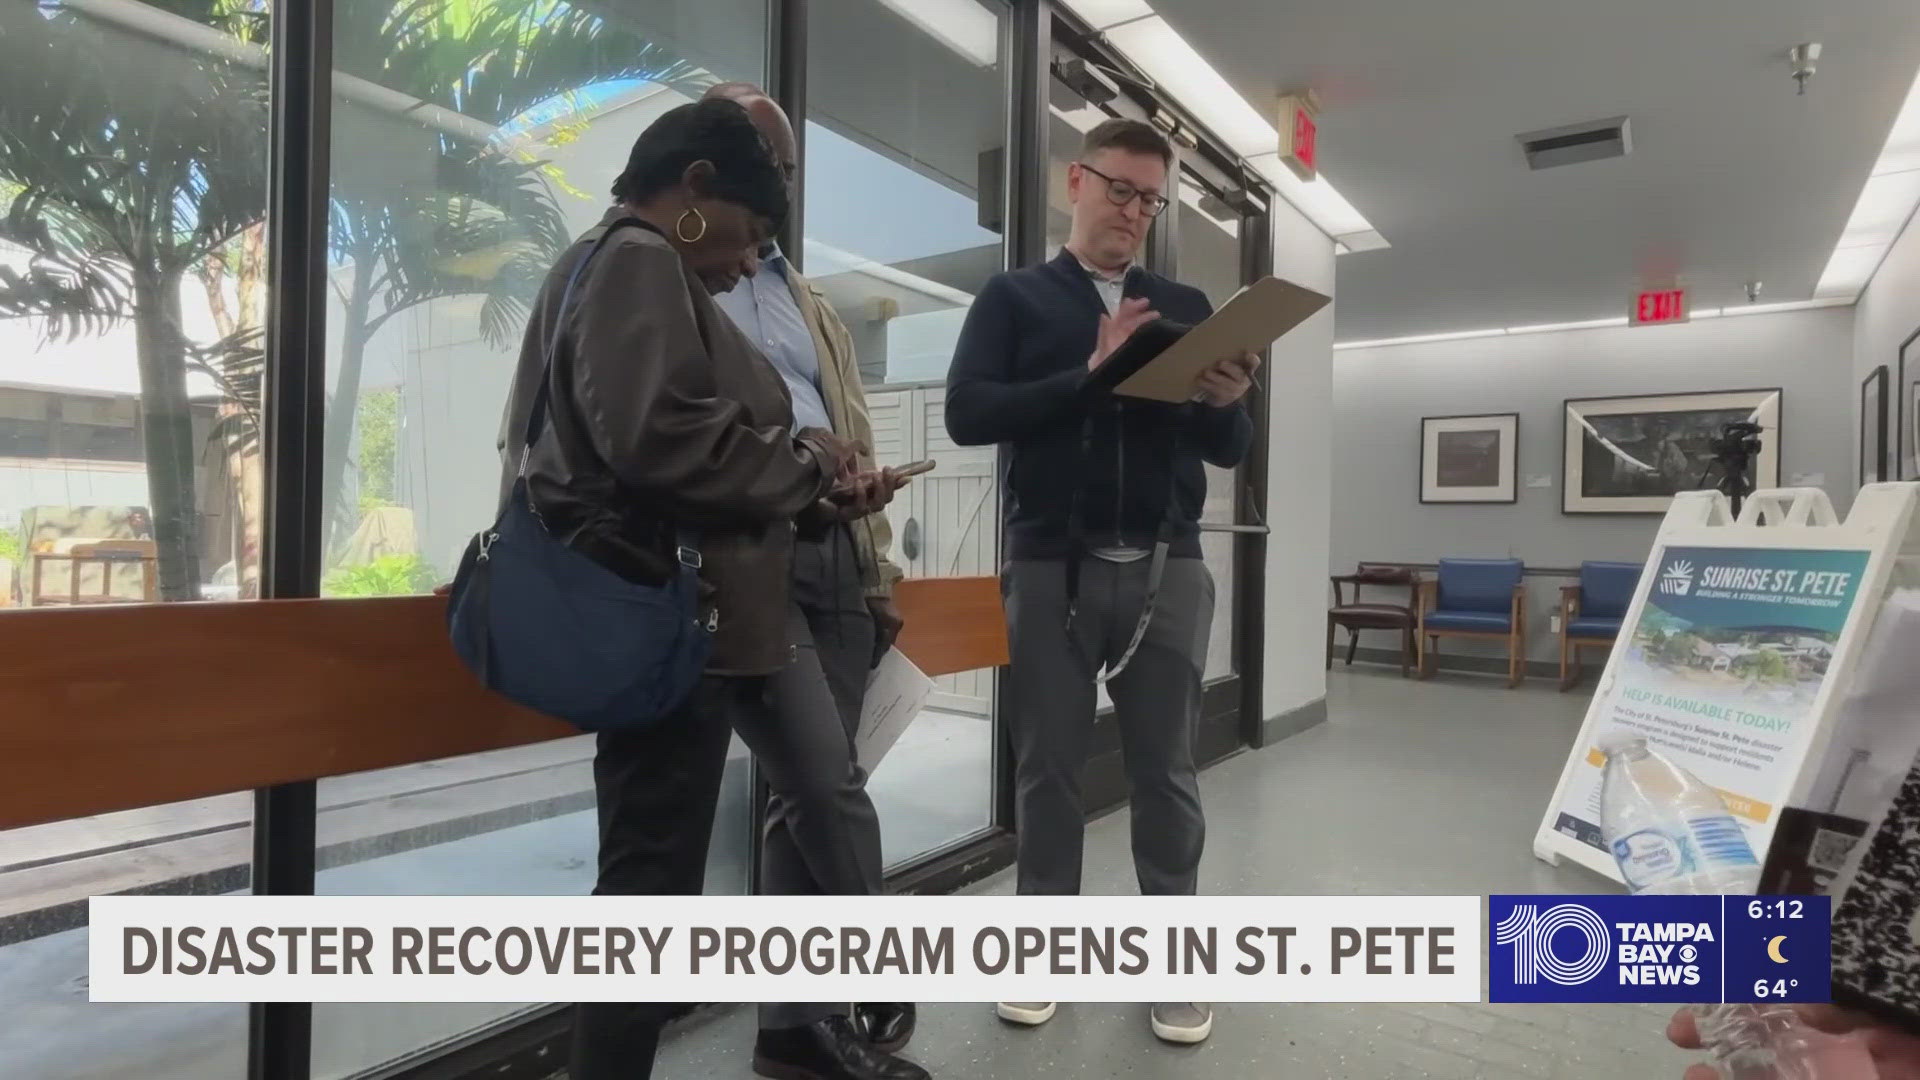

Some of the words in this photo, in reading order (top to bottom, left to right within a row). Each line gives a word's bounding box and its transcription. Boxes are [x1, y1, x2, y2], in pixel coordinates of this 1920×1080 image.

[1637, 290, 1683, 322] EXIT
[1700, 566, 1771, 592] SUNRISE
[1771, 569, 1796, 593] ST.
[1799, 571, 1851, 597] PETE
[1696, 590, 1731, 600] BUILDING
[1738, 593, 1784, 604] STRONGER
[1784, 595, 1844, 608] TOMORROW
[1622, 686, 1652, 702] HELP
[1652, 693, 1663, 706] IS
[1664, 695, 1733, 721] AVAILABLE
[1736, 711, 1791, 734] TODAY!
[1694, 724, 1720, 738] Sunrise
[1732, 734, 1750, 745] Pete
[1751, 739, 1783, 752] disaster
[1709, 740, 1738, 754] support
